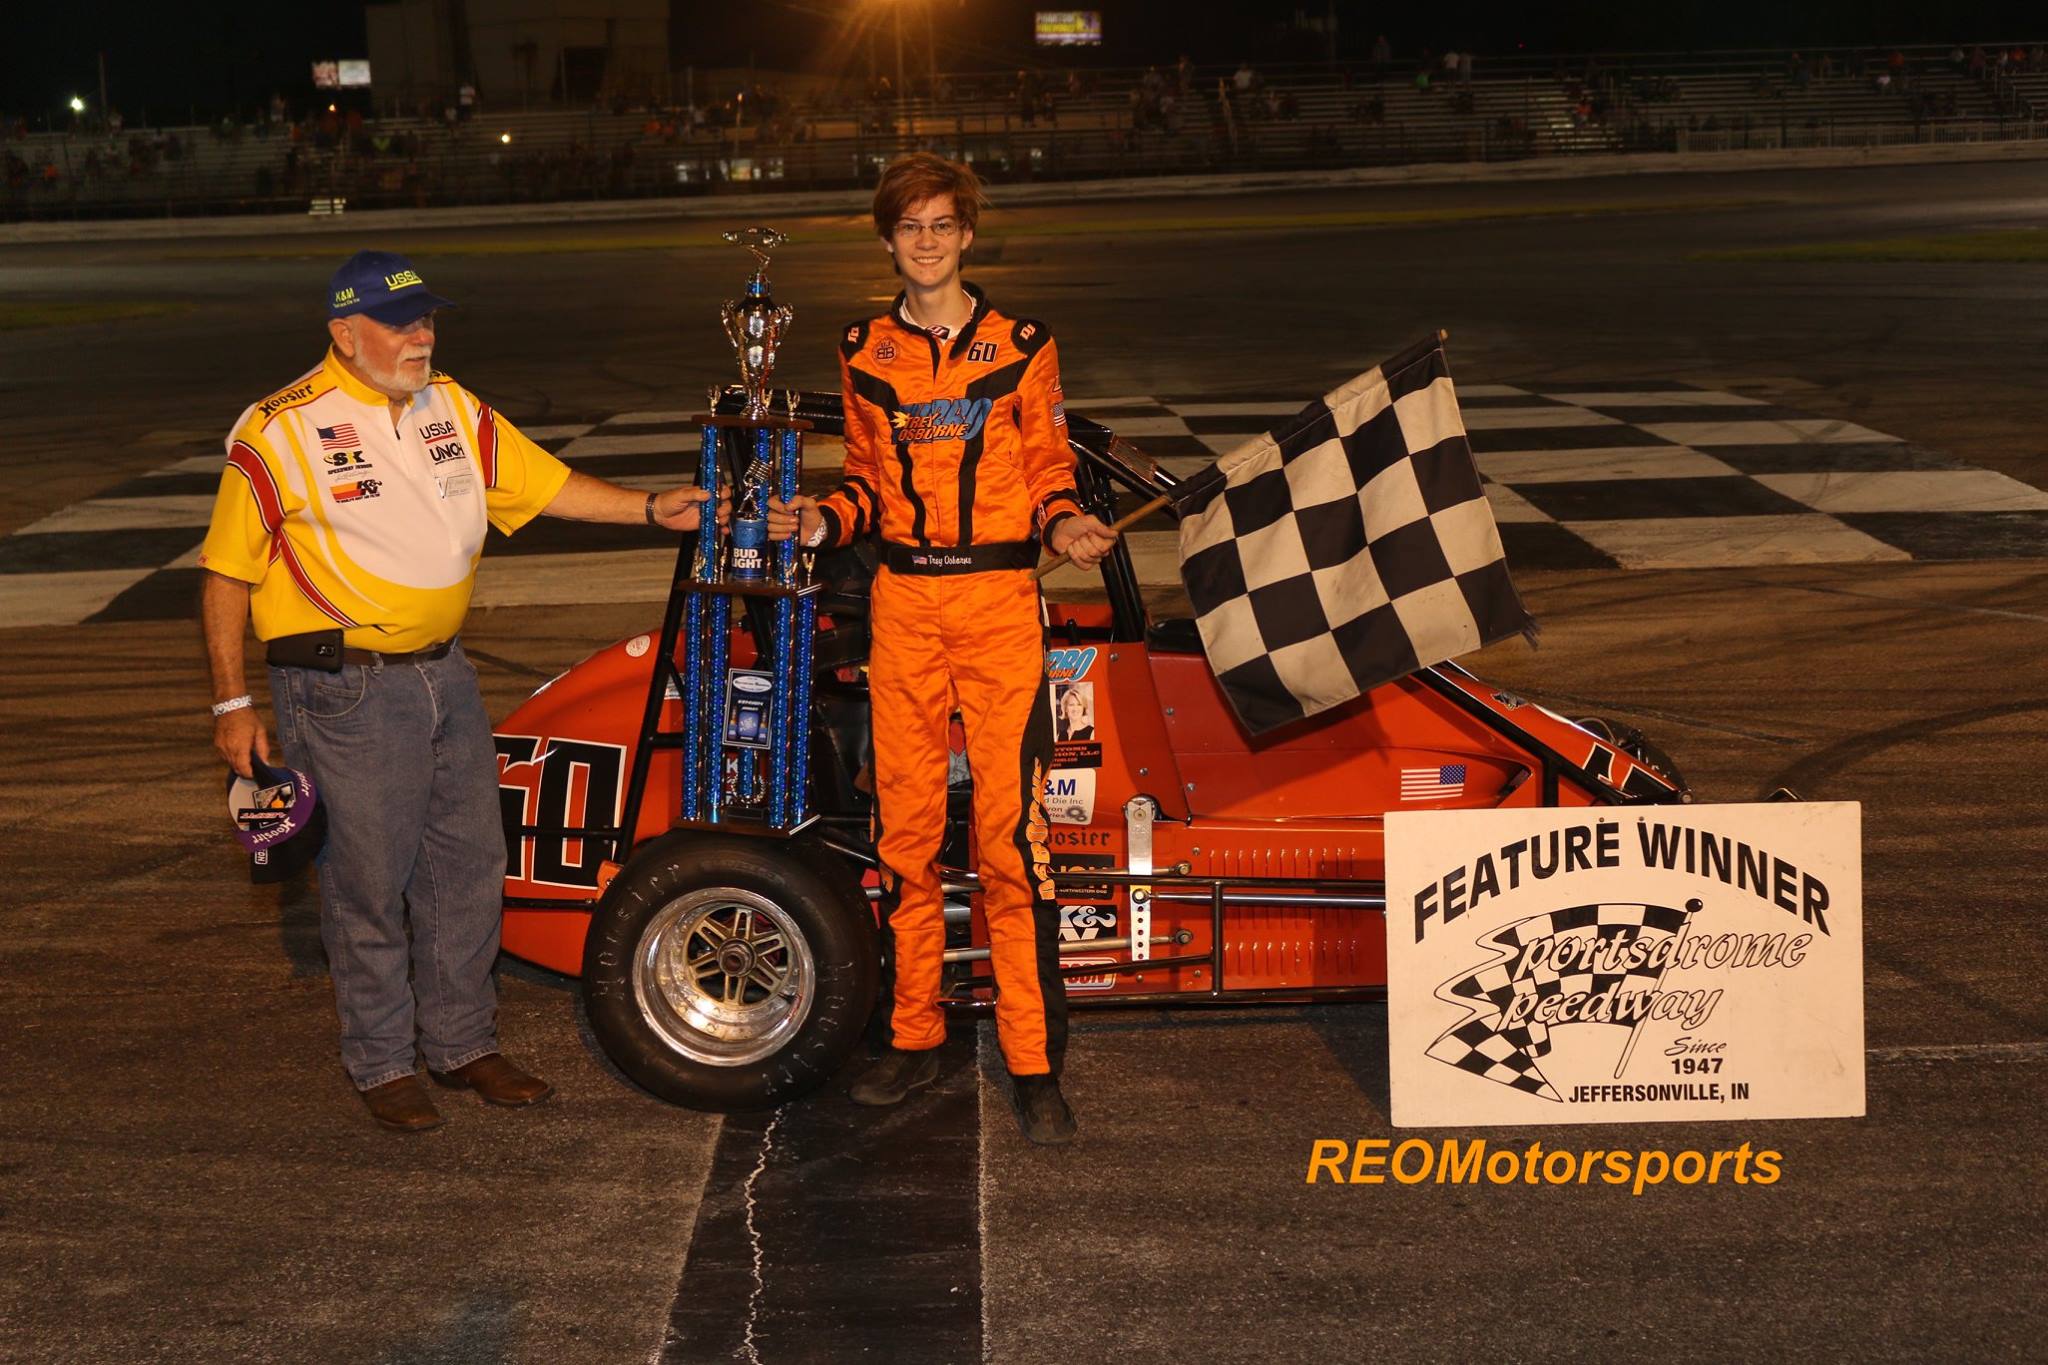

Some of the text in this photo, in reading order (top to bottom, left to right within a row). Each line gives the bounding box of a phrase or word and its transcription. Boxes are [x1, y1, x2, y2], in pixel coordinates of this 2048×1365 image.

[384, 270, 421, 287] USSA
[966, 341, 997, 362] 60
[258, 384, 313, 419] Hoosier
[905, 412, 940, 428] TREY
[419, 420, 456, 440] USSA
[898, 423, 969, 442] OSBORNE
[733, 548, 758, 559] BUD
[731, 558, 762, 569] LIGHT
[1044, 778, 1076, 796] &M
[1070, 798, 1084, 806] Inc
[251, 816, 297, 845] Hoosier
[1049, 827, 1111, 846] osier
[1414, 821, 1832, 945] FEATURE WINNER
[1475, 916, 1814, 983] Sportsdrome
[1434, 975, 1724, 1033] Speedway
[1664, 1036, 1727, 1057] Since
[1671, 1057, 1724, 1075] 1947
[1568, 1082, 1750, 1104] JEFFERSONVILLE, IN
